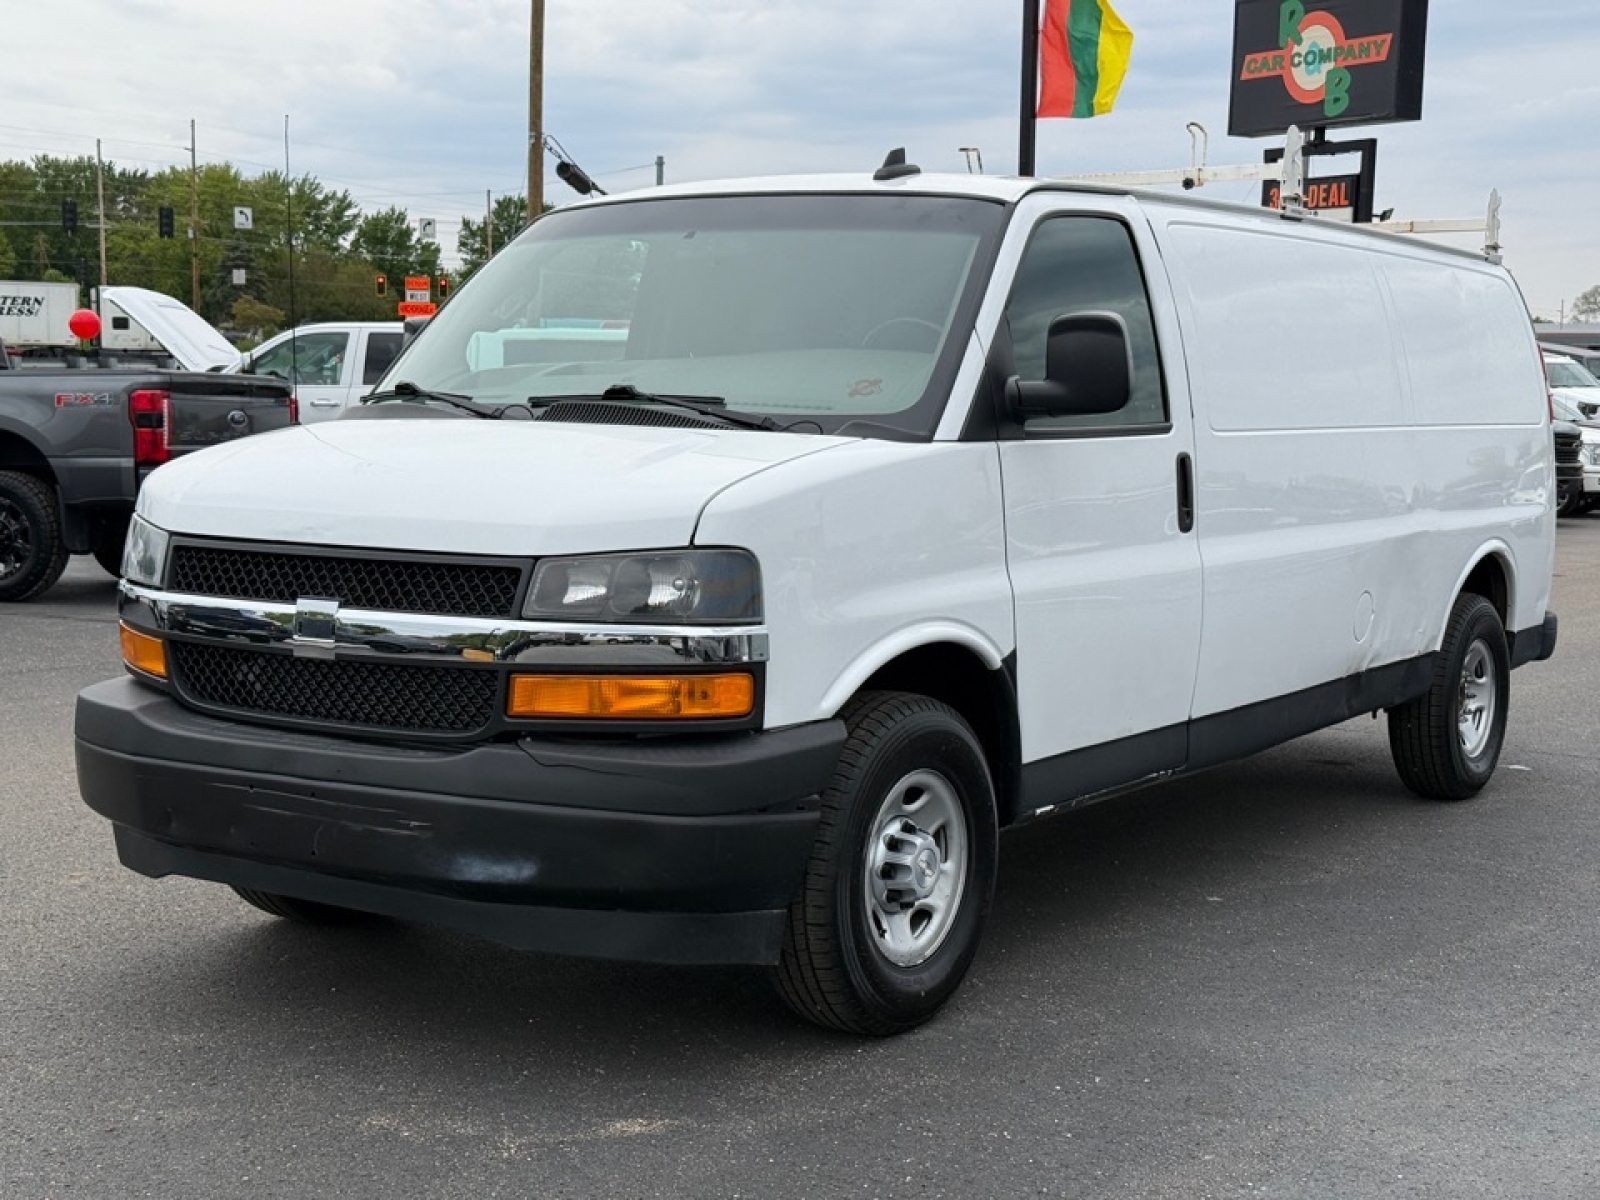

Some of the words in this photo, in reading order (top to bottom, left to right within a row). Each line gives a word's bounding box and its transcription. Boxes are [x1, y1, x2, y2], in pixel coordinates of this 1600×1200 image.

[1246, 56, 1284, 74] CAR
[1290, 40, 1385, 67] COMPANY
[55, 393, 111, 408] FX4
